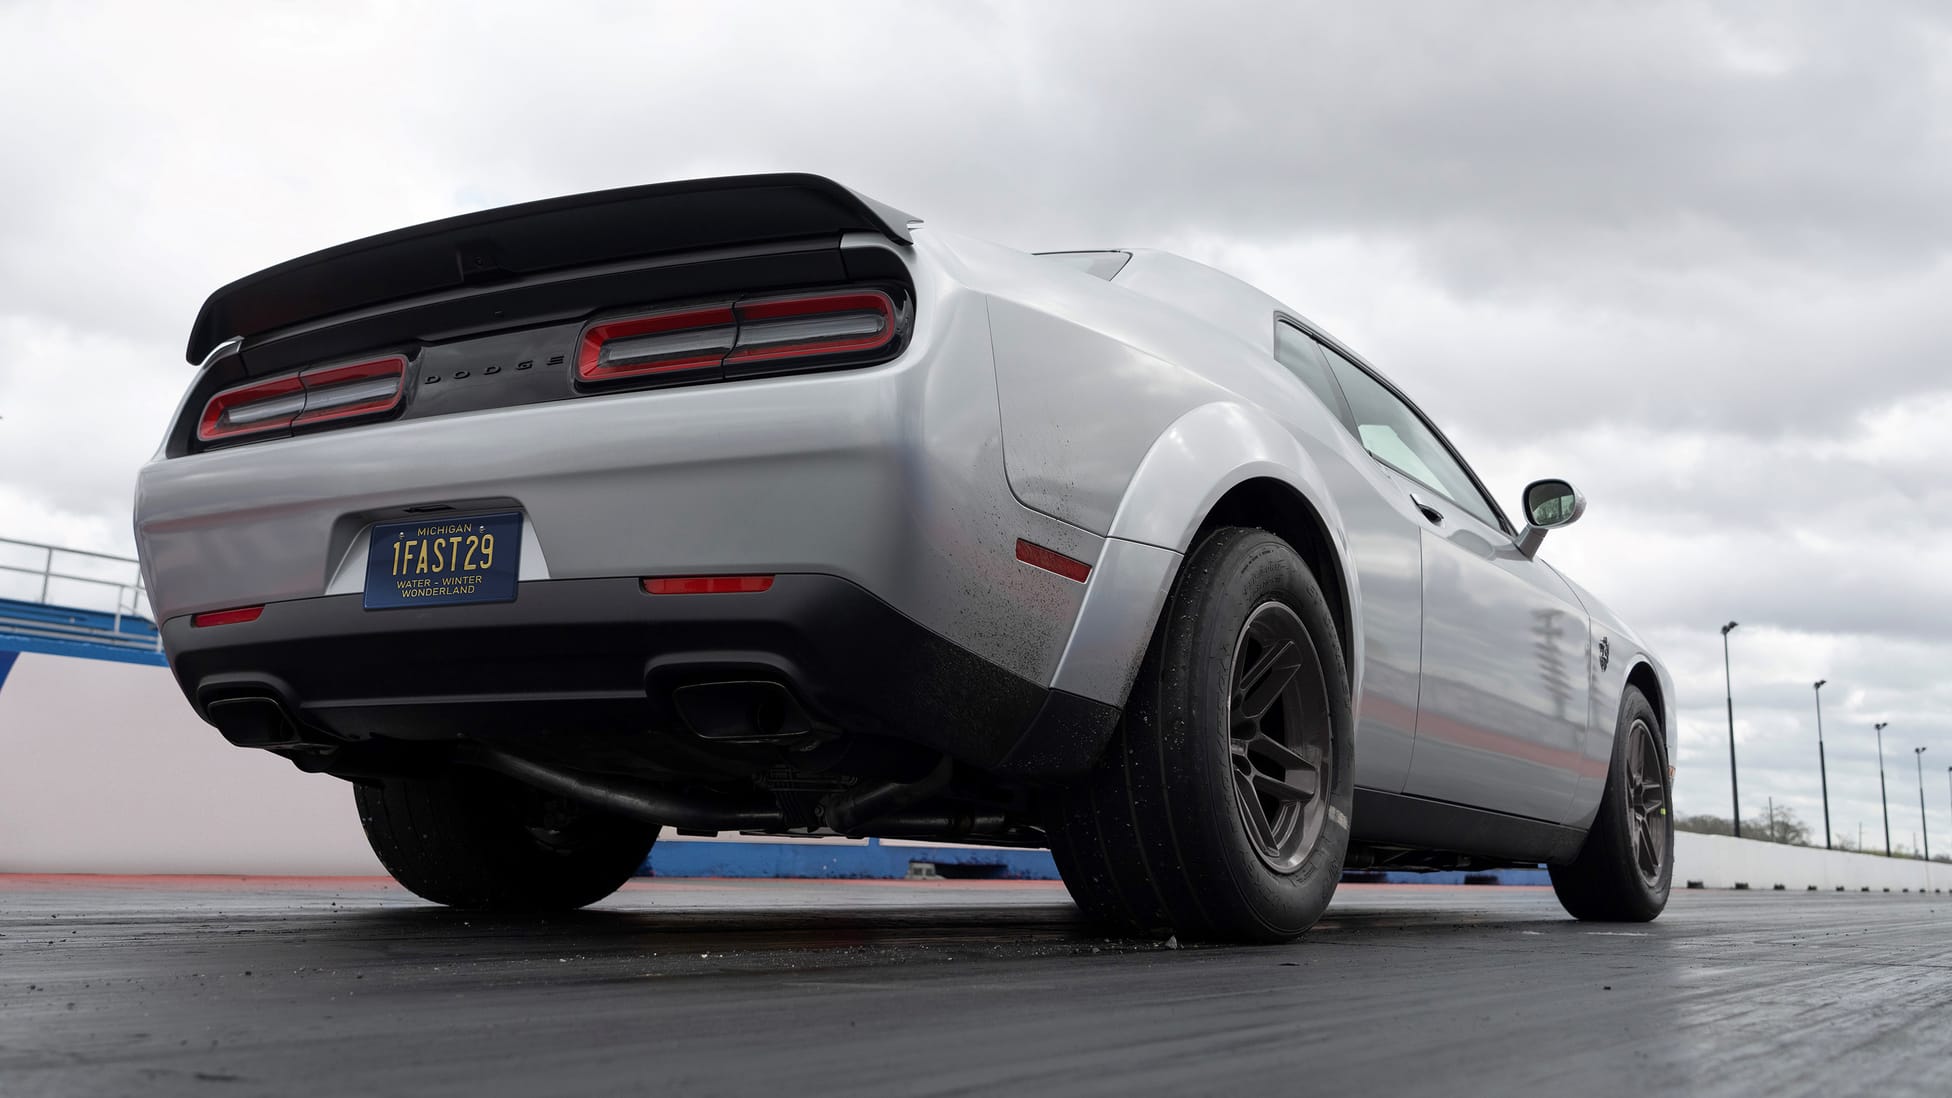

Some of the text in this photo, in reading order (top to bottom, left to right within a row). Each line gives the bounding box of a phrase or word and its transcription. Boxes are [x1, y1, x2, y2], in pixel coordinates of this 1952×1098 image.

[424, 355, 565, 385] DODGE
[417, 523, 472, 537] MICHIGAN
[392, 533, 495, 576] 1FAST29
[396, 578, 431, 589] WATER
[442, 575, 482, 586] WINTER
[401, 585, 475, 598] WONDERLAND
